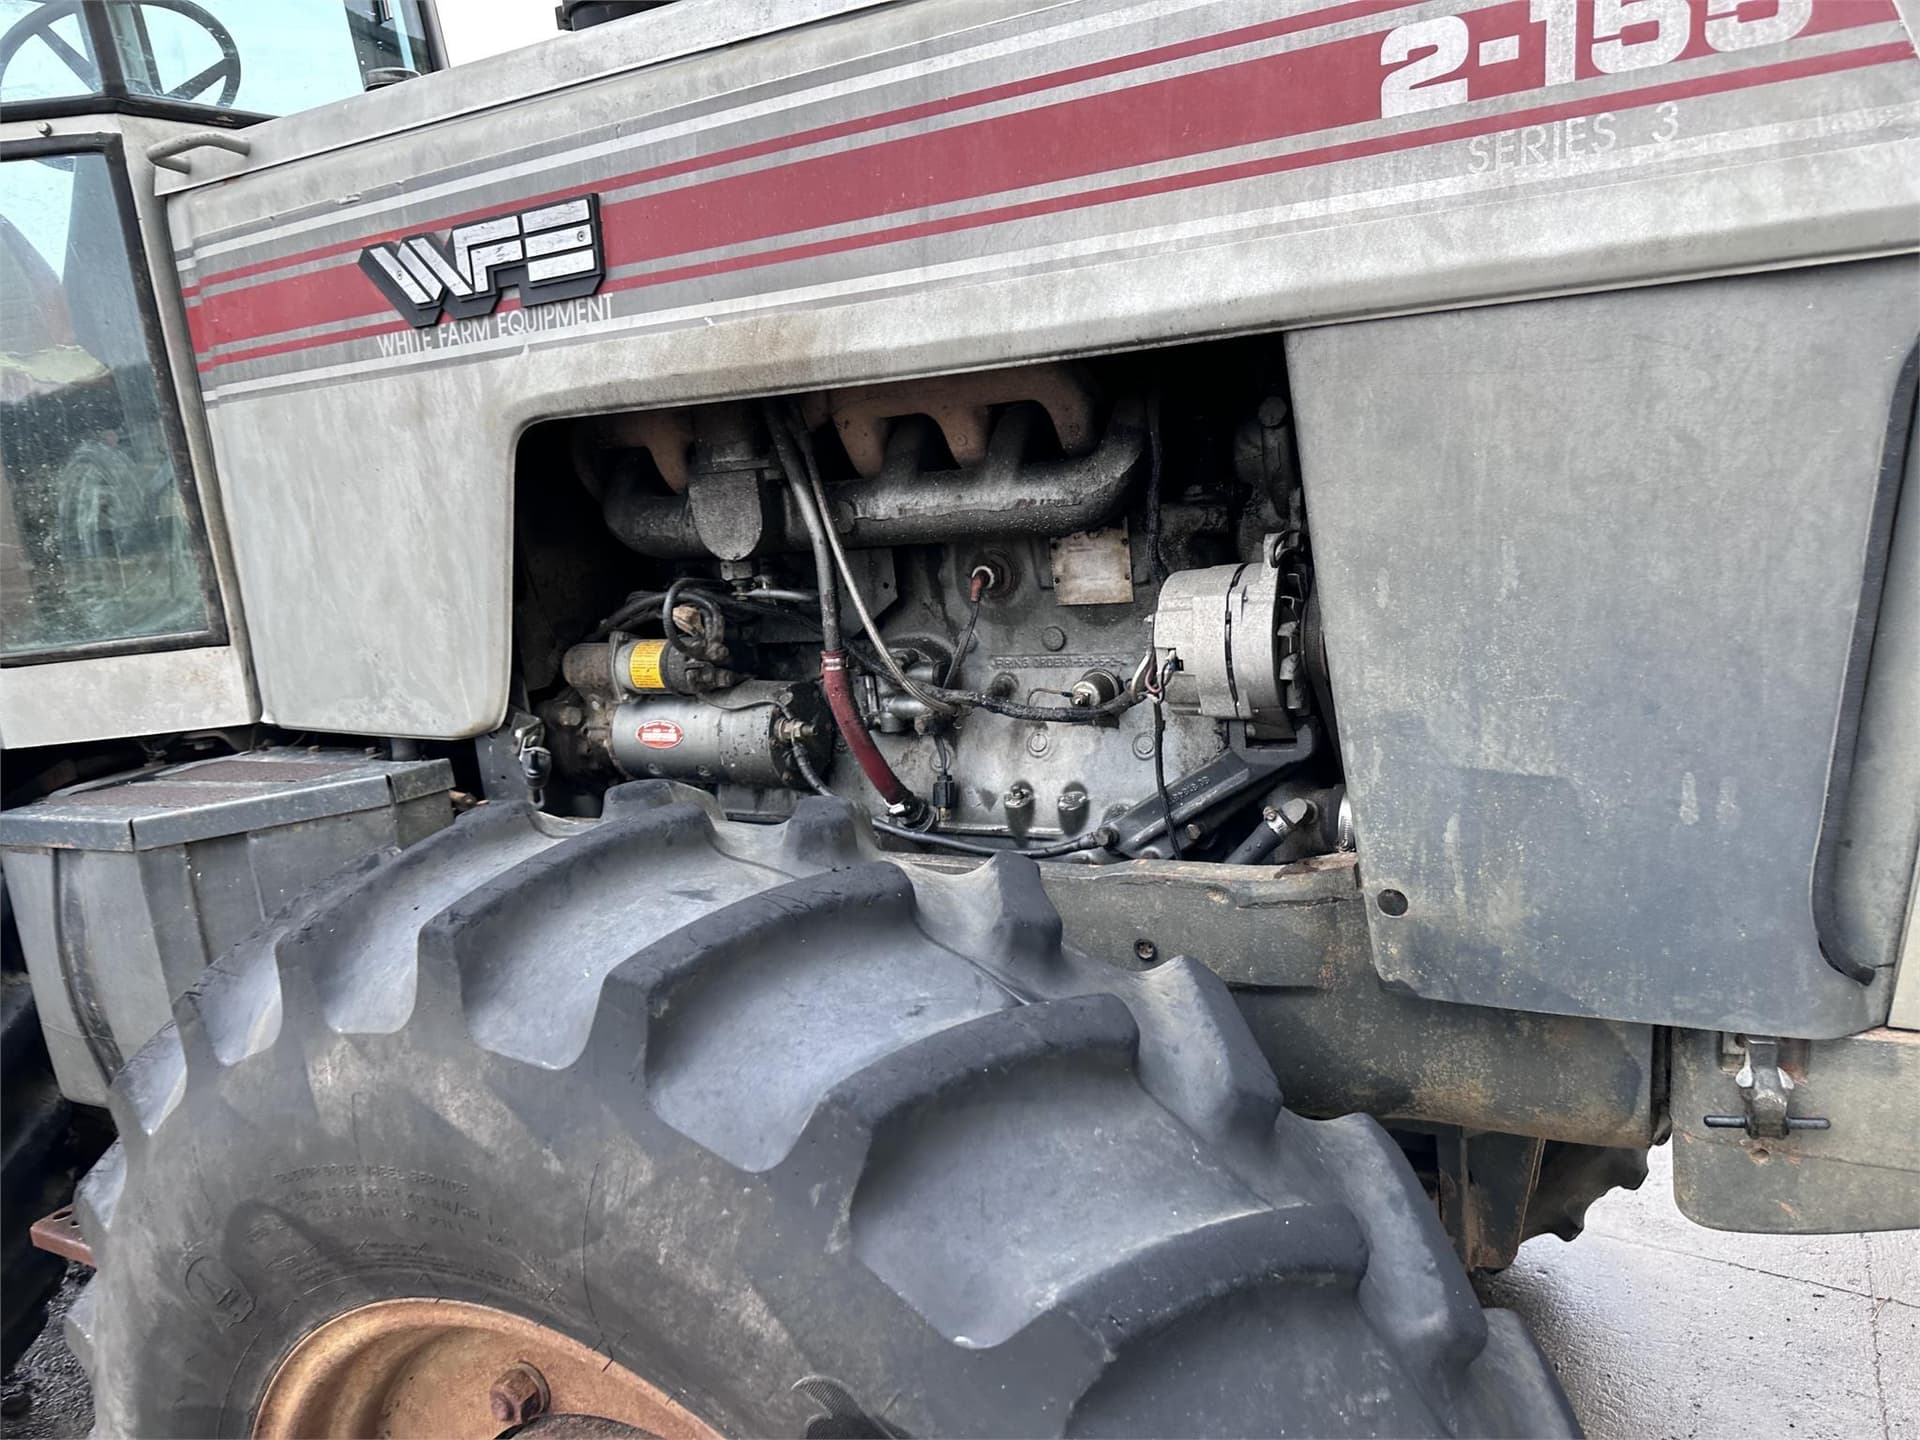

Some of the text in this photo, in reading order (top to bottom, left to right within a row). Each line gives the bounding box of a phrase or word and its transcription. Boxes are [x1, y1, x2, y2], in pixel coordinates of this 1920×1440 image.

[1466, 101, 1679, 174] SERIES 3
[364, 196, 599, 306] WFE
[376, 293, 614, 357] WHITE FARM EQUIPMENT
